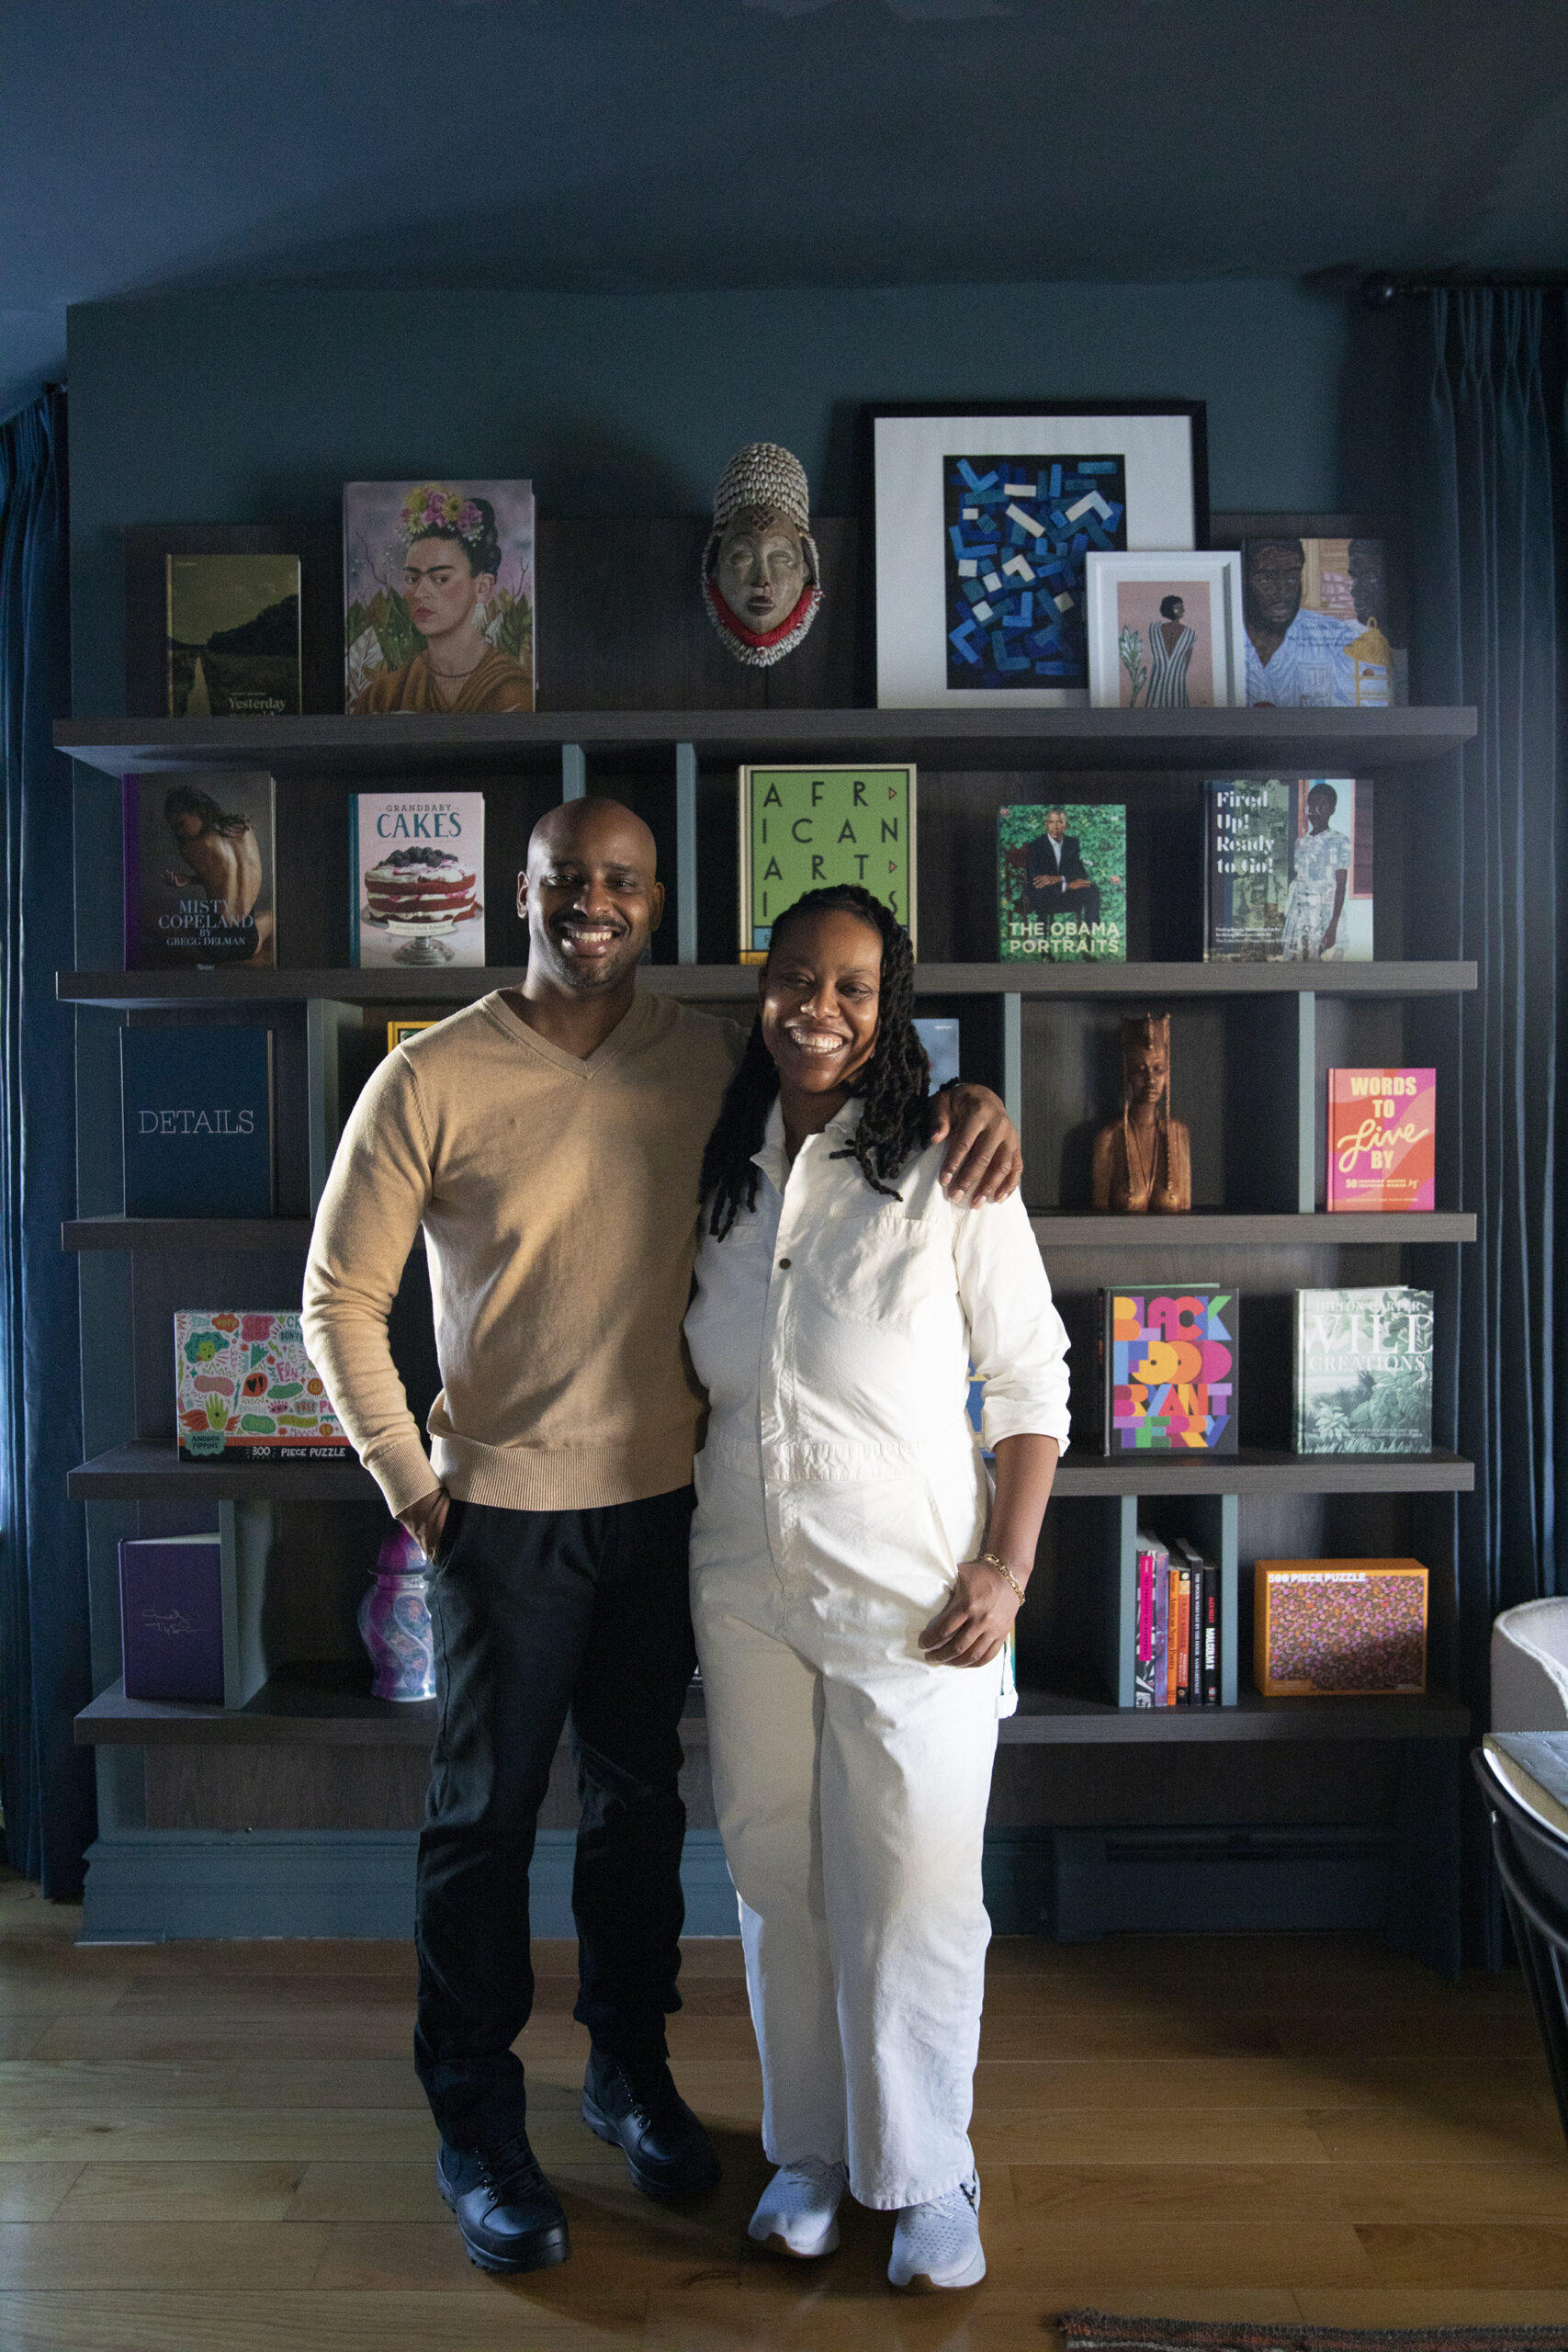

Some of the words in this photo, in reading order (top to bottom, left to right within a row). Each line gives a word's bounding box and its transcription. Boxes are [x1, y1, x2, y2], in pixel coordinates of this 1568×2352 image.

[229, 698, 287, 713] Yesterday
[386, 804, 452, 812] GRANDBABY
[1217, 791, 1269, 808] Fired
[377, 812, 462, 838] CAKES
[1217, 814, 1249, 833] Up!
[1217, 835, 1275, 854] Ready
[1217, 858, 1235, 874] to
[1241, 858, 1274, 874] Go!
[179, 899, 230, 913] MISTY
[158, 913, 254, 929] COPELAND
[1009, 922, 1044, 936] THE
[1050, 922, 1121, 936] OBAMA
[166, 937, 201, 946] GREGG
[203, 937, 246, 946] DELMAN
[199, 928, 211, 937] BY
[1010, 939, 1119, 954] PORTRAITS
[1350, 1076, 1416, 1096] WORDS
[1372, 1099, 1395, 1118] TO
[138, 1110, 254, 1134] DETAILS
[1337, 1118, 1429, 1172] Live
[1371, 1150, 1394, 1169] BY
[1315, 1301, 1364, 1312] HILTON
[1369, 1301, 1421, 1312] CARTER
[1113, 1295, 1232, 1340] BLACK
[1303, 1314, 1433, 1353] WILD
[1113, 1340, 1232, 1385] FOOD
[1309, 1355, 1426, 1372] CREATIONS
[276, 1362, 299, 1382] Fly
[296, 1402, 316, 1413] FREE
[1113, 1384, 1233, 1417] BRYANT
[1113, 1415, 1231, 1449] TERRY
[252, 1446, 271, 1456] 300
[281, 1447, 308, 1457] PIECE
[310, 1447, 346, 1457] PUZZLE
[1291, 1573, 1324, 1582] PIECE
[1325, 1572, 1366, 1582] PUZZLE
[1205, 1627, 1215, 1664] MALCOLM
